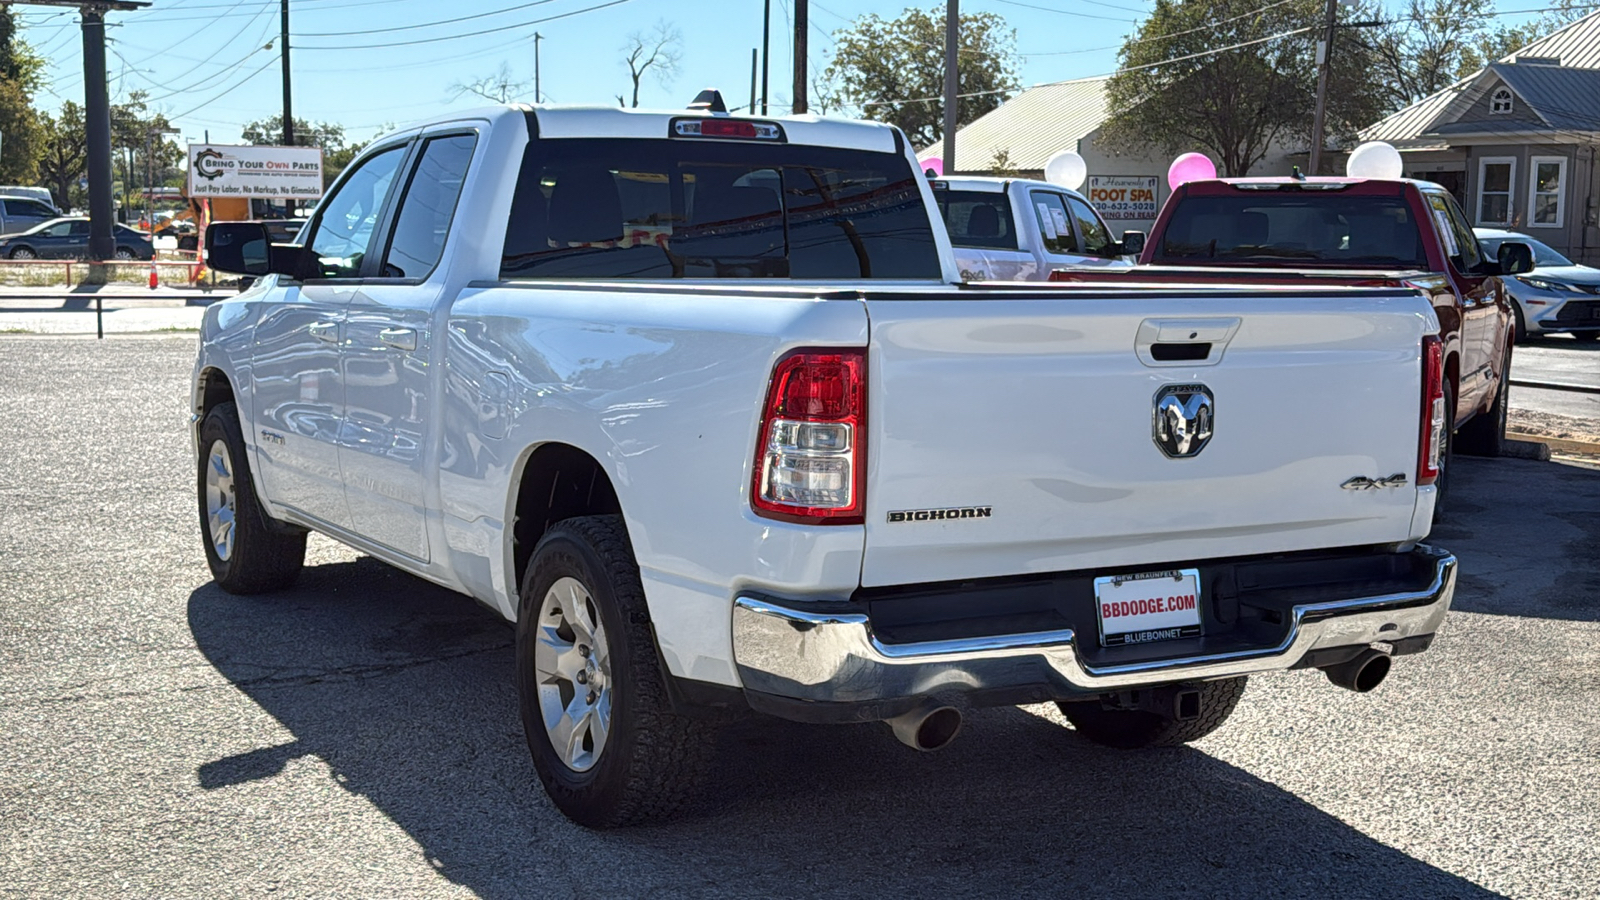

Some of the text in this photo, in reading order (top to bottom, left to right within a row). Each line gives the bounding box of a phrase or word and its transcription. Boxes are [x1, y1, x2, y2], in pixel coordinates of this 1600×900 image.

[205, 159, 319, 171] BRING YOUR OWN PARTS
[1102, 177, 1145, 188] Heavenly
[194, 185, 207, 193] Just
[208, 185, 220, 194] Pay
[221, 185, 242, 194] Labor,
[253, 186, 279, 195] Markup,
[280, 186, 290, 194] No
[291, 187, 320, 195] Gimmicks
[1090, 189, 1154, 202] FOOT SPA
[887, 505, 993, 523] BIGHORN
[1135, 570, 1178, 580] BRAUNFELS
[1102, 594, 1196, 619] BBDODGE.COM
[1124, 628, 1182, 643] BLUEBONNET
